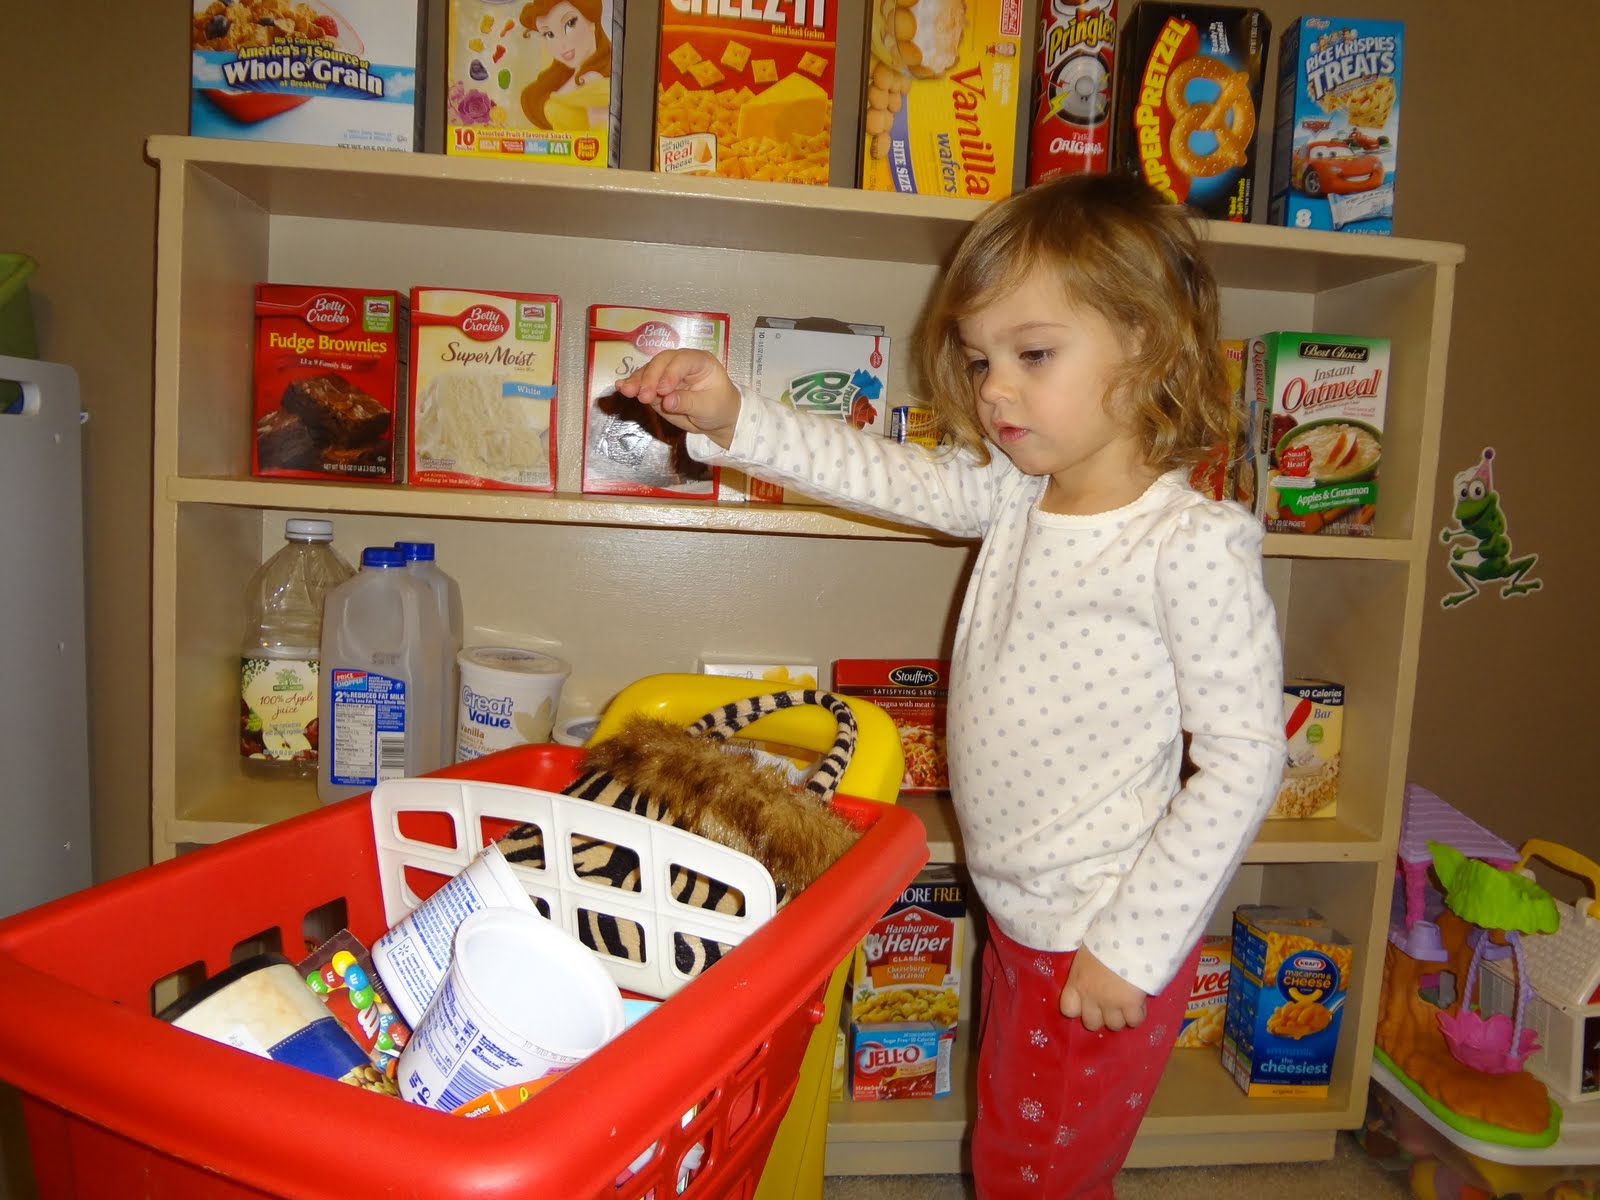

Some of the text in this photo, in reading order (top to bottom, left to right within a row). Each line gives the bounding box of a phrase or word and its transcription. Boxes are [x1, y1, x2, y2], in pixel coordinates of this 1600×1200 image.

[771, 24, 825, 40] Baked Snack Crackers
[1049, 11, 1114, 62] Pringles
[238, 45, 300, 60] America's
[315, 48, 360, 67] Source
[359, 60, 370, 70] of
[1306, 36, 1396, 74] RICE KRISPIES
[223, 58, 384, 97] Whole Grain
[1308, 51, 1396, 100] TREATS
[290, 80, 327, 90] Breakfast
[454, 128, 475, 146] 10
[477, 130, 505, 138] Assorted
[522, 131, 549, 139] Flavored
[550, 132, 572, 140] Snacks
[950, 61, 996, 197] Vanilla
[1073, 132, 1089, 141] THE
[672, 138, 690, 151] 100%
[1050, 137, 1104, 156] ORIGINAL
[664, 142, 693, 165] Real
[893, 140, 913, 193] BITE SIZE
[936, 132, 961, 194] wafers
[1296, 208, 1312, 228] 8
[315, 297, 346, 317] Betty
[306, 309, 350, 325] Crocker
[470, 307, 500, 327] Betty
[463, 319, 504, 334] Crocker
[644, 324, 672, 341] Betty
[269, 332, 388, 354] Fudge Brownies
[636, 335, 677, 349] Crocker
[758, 331, 765, 339] 10
[1303, 344, 1366, 361] Best Choice
[319, 360, 340, 371] Family
[341, 362, 353, 370] Size
[1313, 364, 1355, 383] Instant
[517, 385, 541, 396] White
[1281, 368, 1383, 413] Oatmeal
[842, 386, 856, 414] FRUIT
[1286, 451, 1307, 459] Smart
[1297, 486, 1369, 506] Apples & Cinnamon
[336, 673, 354, 681] PRICE
[336, 678, 363, 688] CHOPPER
[894, 670, 934, 685] Stouffer's
[259, 691, 315, 707] 100% Apple
[462, 684, 514, 717] Great
[873, 688, 917, 697] SATISFYING
[1300, 688, 1342, 698] 90 Calories
[271, 706, 300, 720] juice
[874, 700, 898, 711] lasagna
[899, 700, 914, 709] with
[914, 701, 930, 709] meat
[1314, 708, 1333, 719] Bar
[468, 709, 511, 730] Value
[460, 723, 485, 740] Vanilla
[885, 923, 940, 936] Hamburger
[884, 934, 951, 956] Helper
[892, 955, 926, 963] CLASSIC
[887, 965, 931, 975] Cheeseburger
[892, 972, 926, 980] Macaroni
[1285, 969, 1326, 980] macaroni
[865, 1045, 921, 1069] JELL-O
[1260, 1059, 1328, 1075] cheesiest
